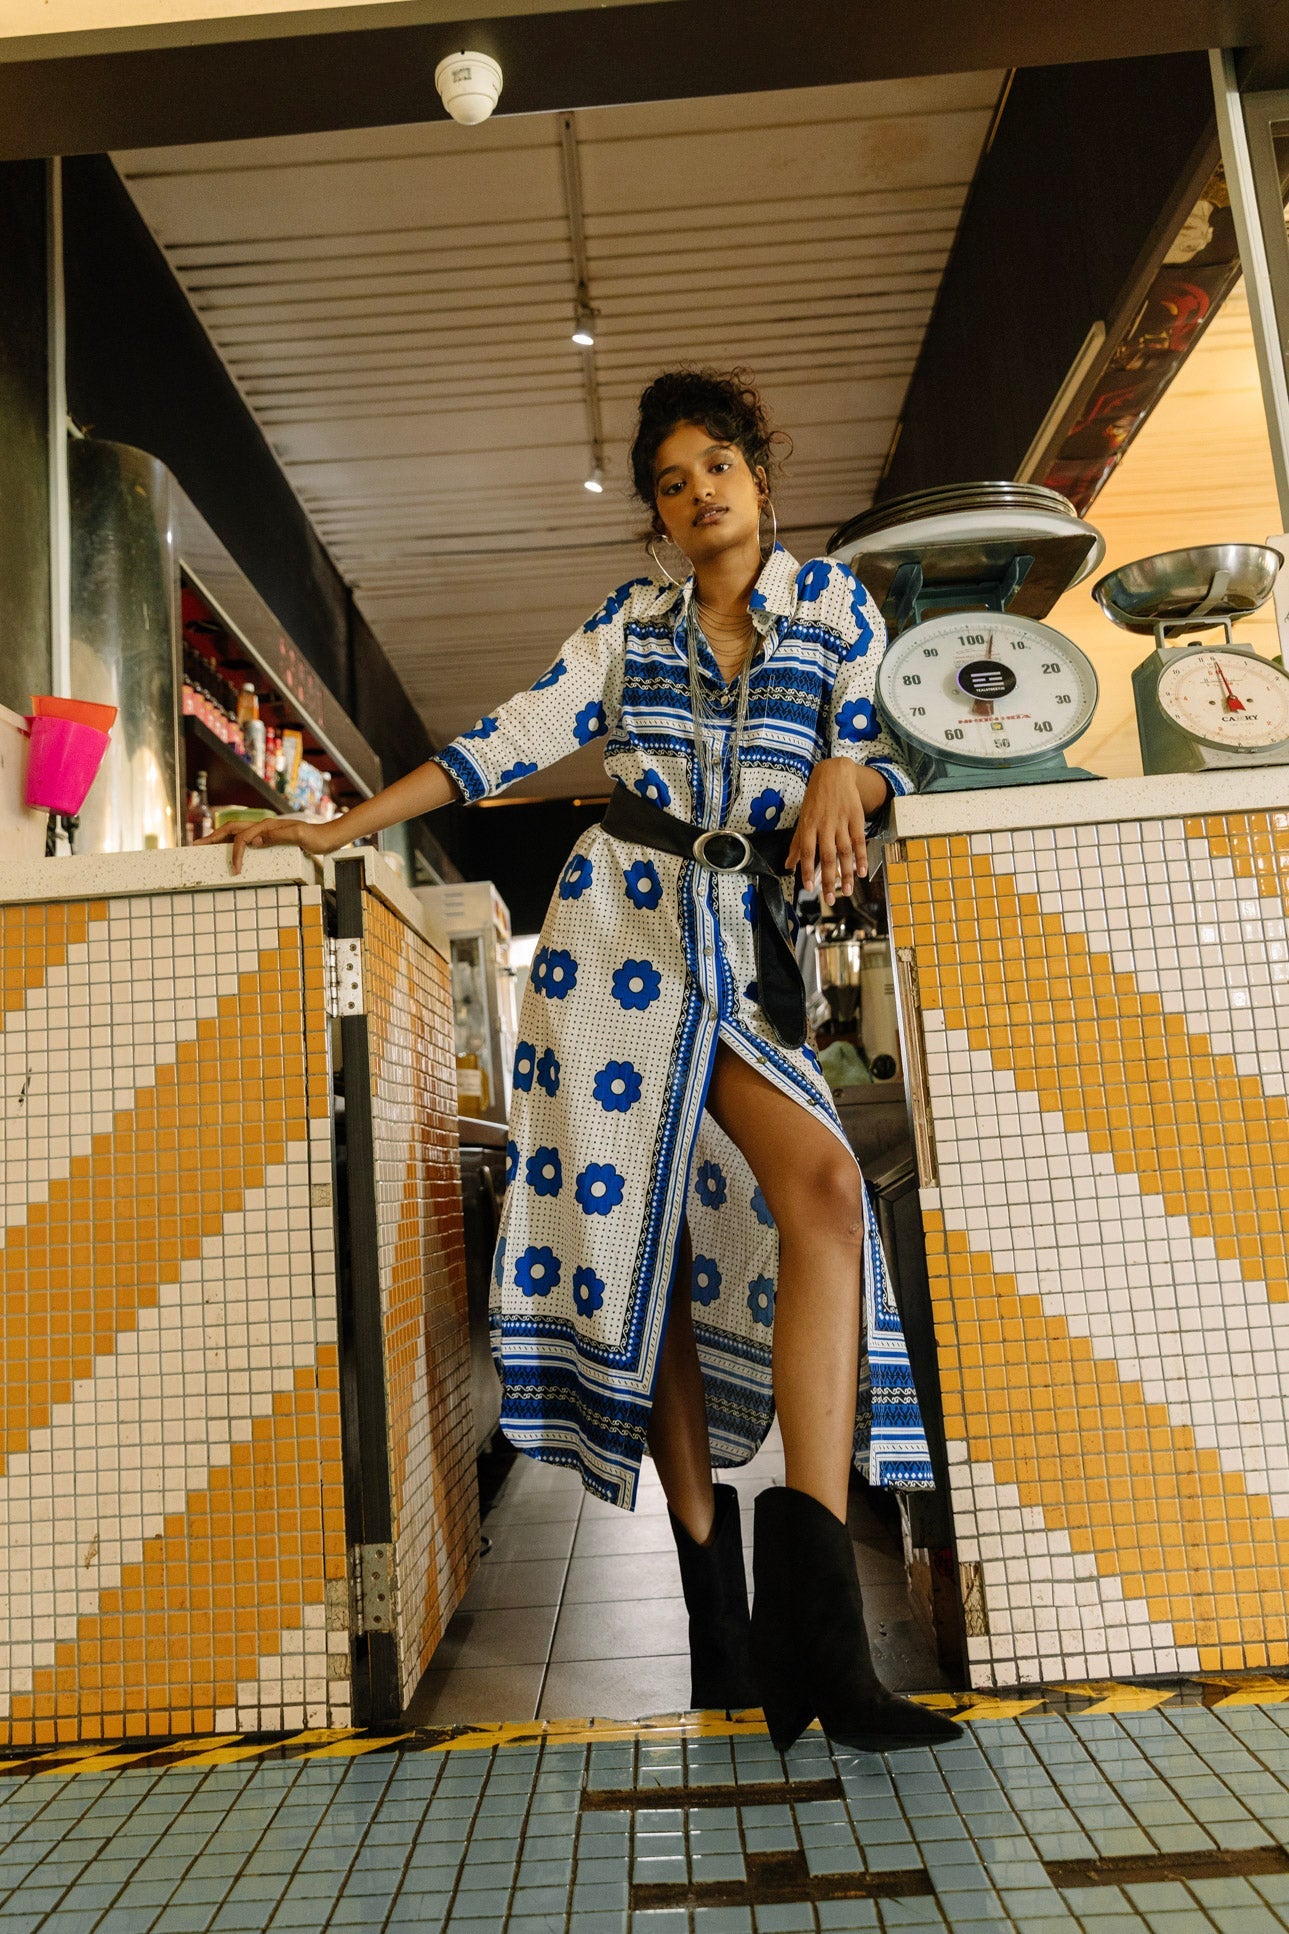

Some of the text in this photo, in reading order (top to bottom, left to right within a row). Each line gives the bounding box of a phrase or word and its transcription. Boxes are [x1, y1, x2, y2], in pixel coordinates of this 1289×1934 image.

[958, 634, 985, 646] 100
[1009, 641, 1025, 650] 10
[923, 648, 938, 657] 90
[1041, 663, 1061, 674] 20
[902, 674, 921, 686] 80
[1055, 694, 1072, 705] 30
[909, 707, 926, 717] 70
[1034, 721, 1053, 733] 40
[944, 728, 964, 740] 60
[994, 738, 1010, 749] 50
